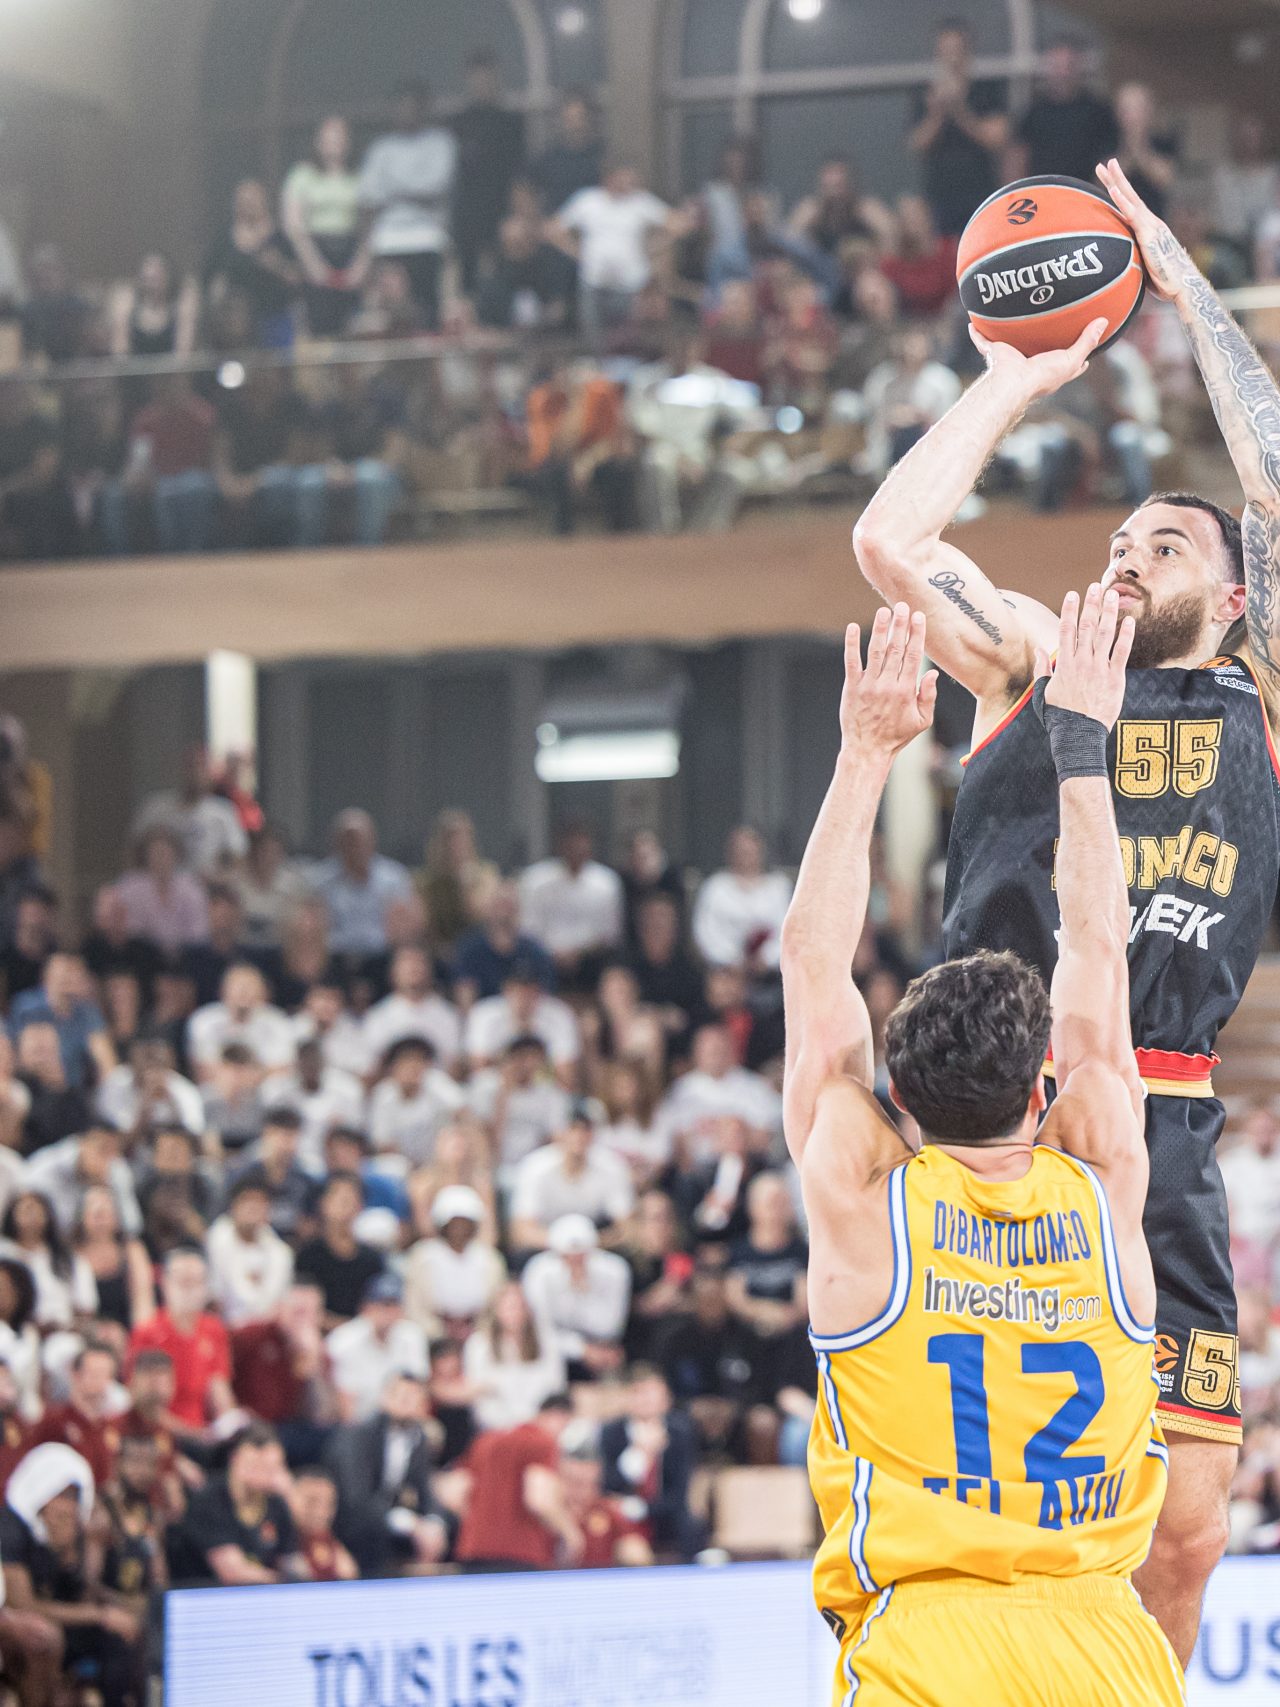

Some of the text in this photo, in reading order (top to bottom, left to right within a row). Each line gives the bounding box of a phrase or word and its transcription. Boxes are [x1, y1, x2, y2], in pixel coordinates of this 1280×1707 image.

[975, 242, 1103, 304] SPALDING
[928, 571, 1003, 645] Determination
[1115, 719, 1223, 798] 55
[1052, 826, 1239, 897] NACO
[927, 1333, 1106, 1482] 12
[1181, 1328, 1241, 1414] 5
